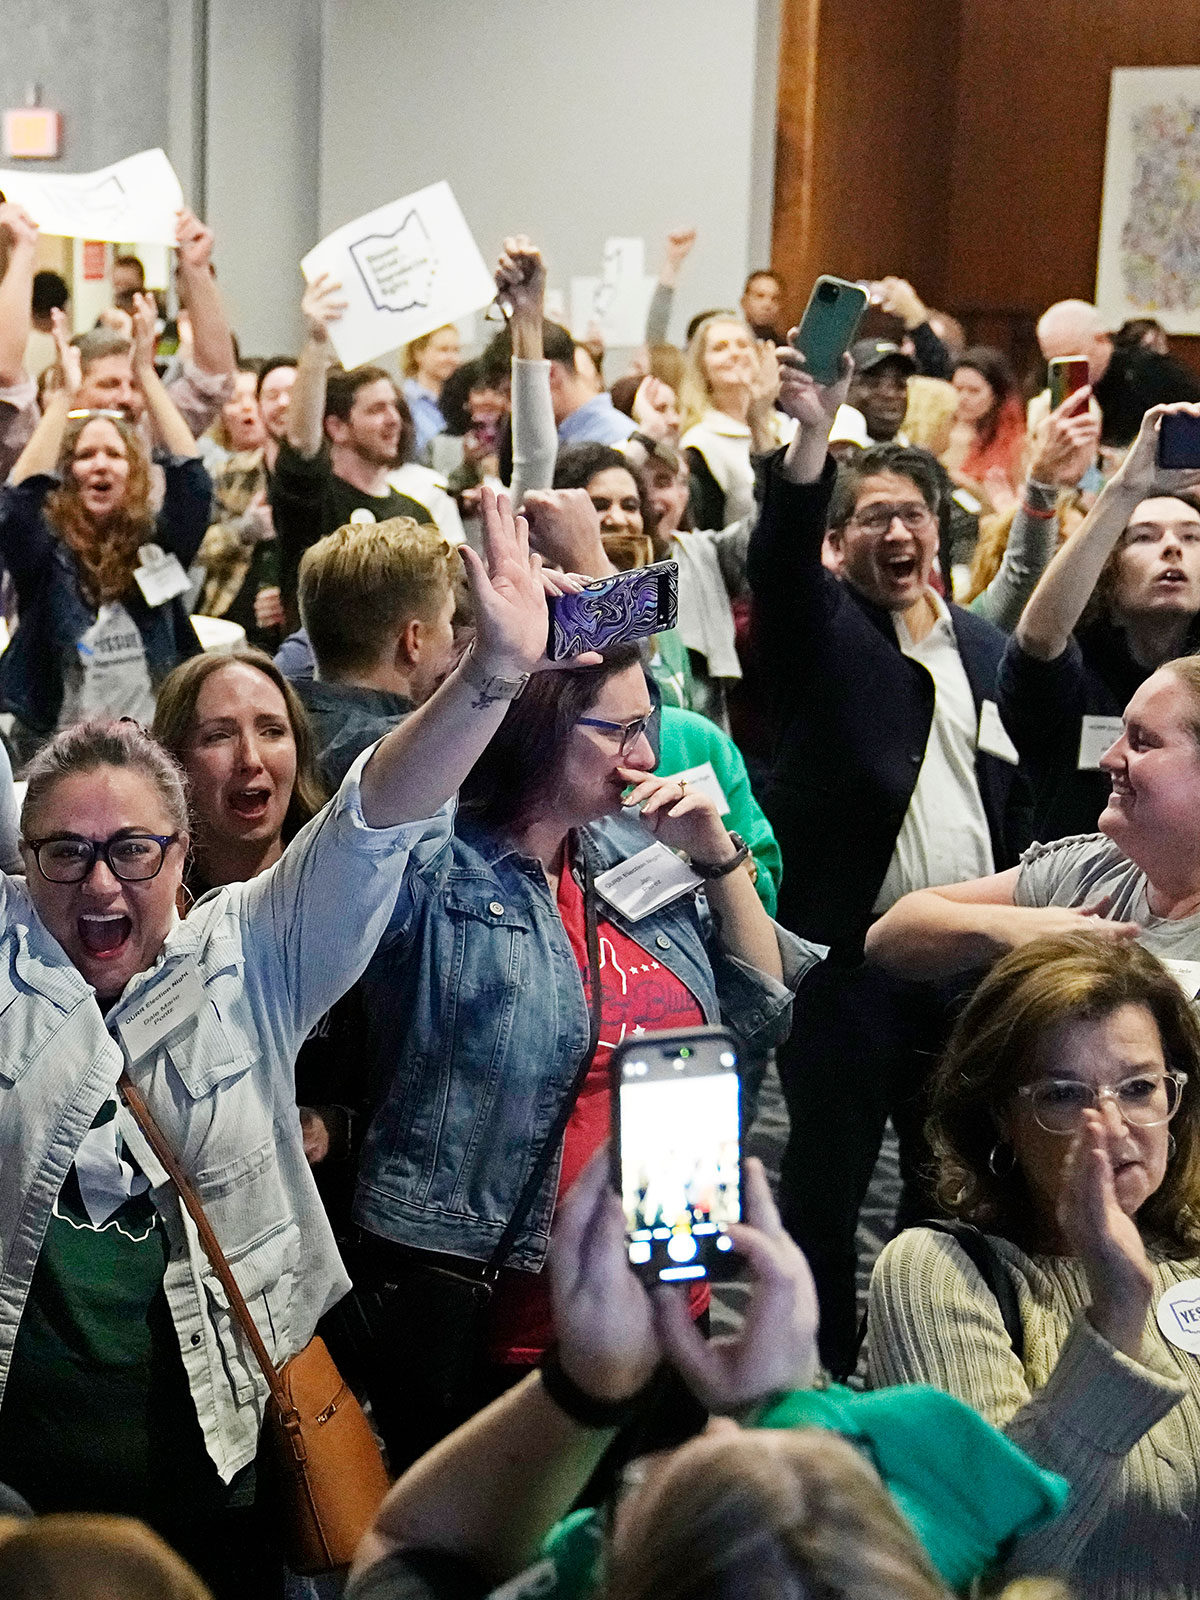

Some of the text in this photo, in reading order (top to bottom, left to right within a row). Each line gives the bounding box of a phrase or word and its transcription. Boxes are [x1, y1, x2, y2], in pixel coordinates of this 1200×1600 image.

[125, 971, 189, 1025] OURR Election Night
[143, 994, 180, 1026] Dale Marie
